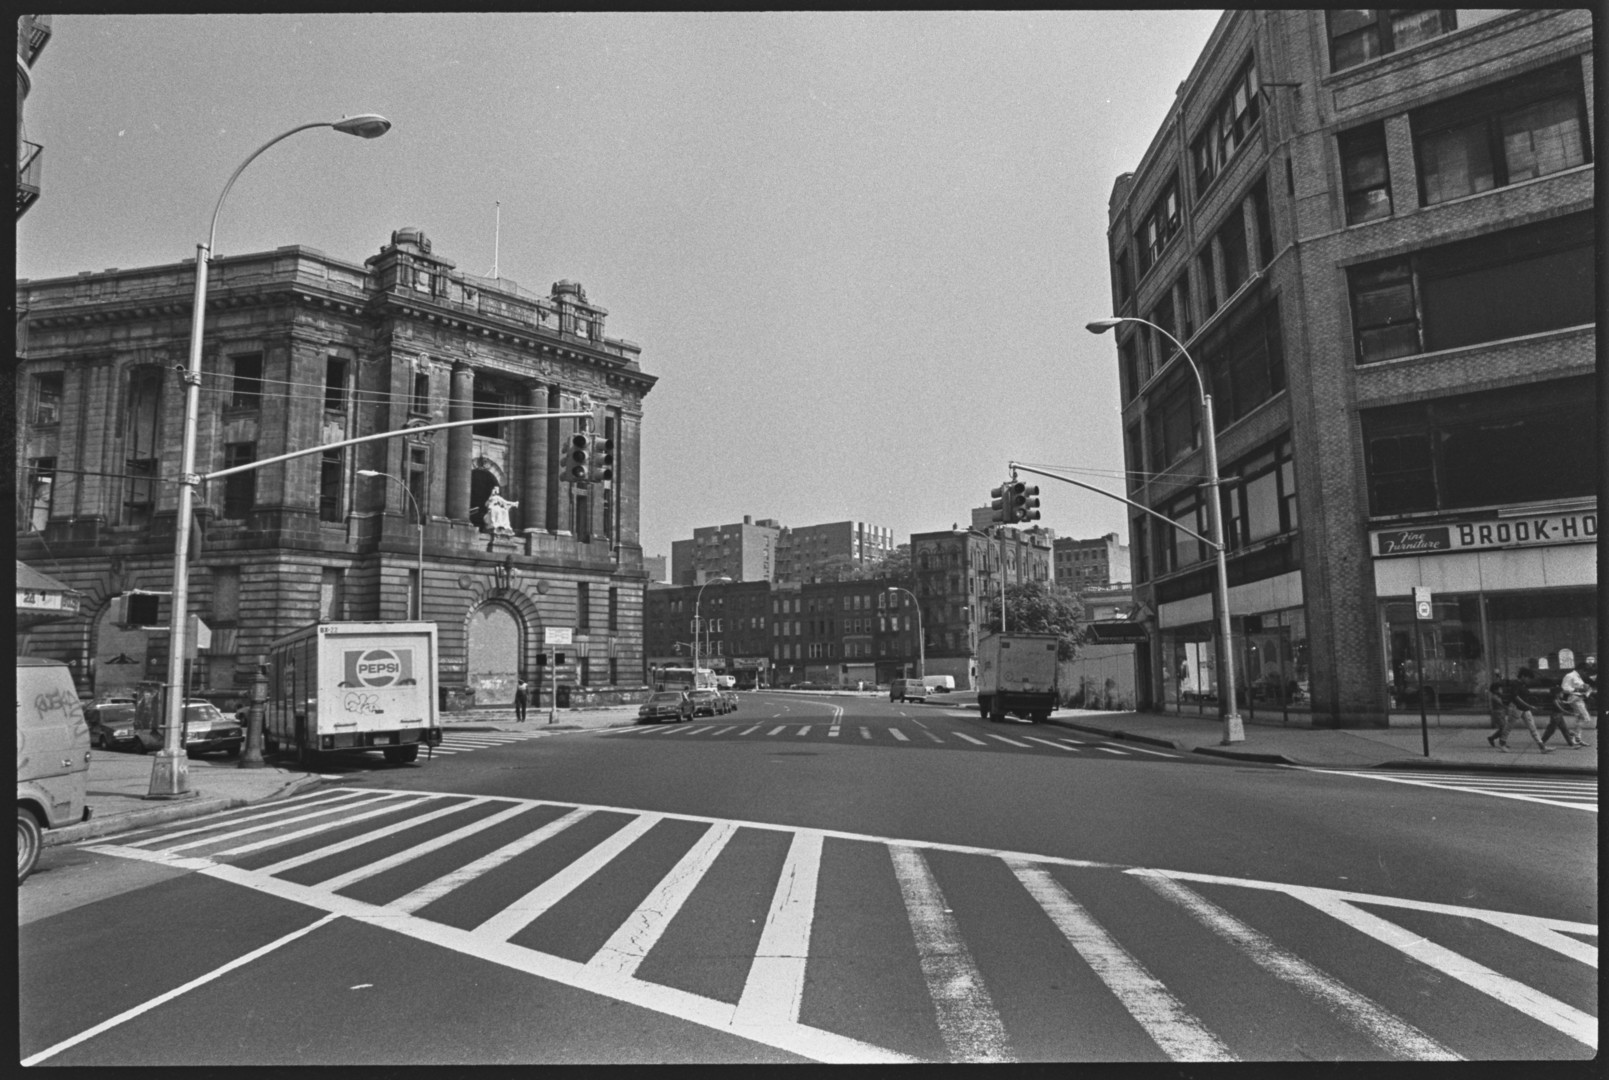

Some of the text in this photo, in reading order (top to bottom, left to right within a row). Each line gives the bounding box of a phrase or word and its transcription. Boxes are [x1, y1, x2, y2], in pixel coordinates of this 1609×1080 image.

[1456, 515, 1597, 546] BROOK-HO
[1398, 531, 1425, 544] Fine
[1383, 539, 1440, 552] Furniture
[358, 663, 399, 674] PEPSI
